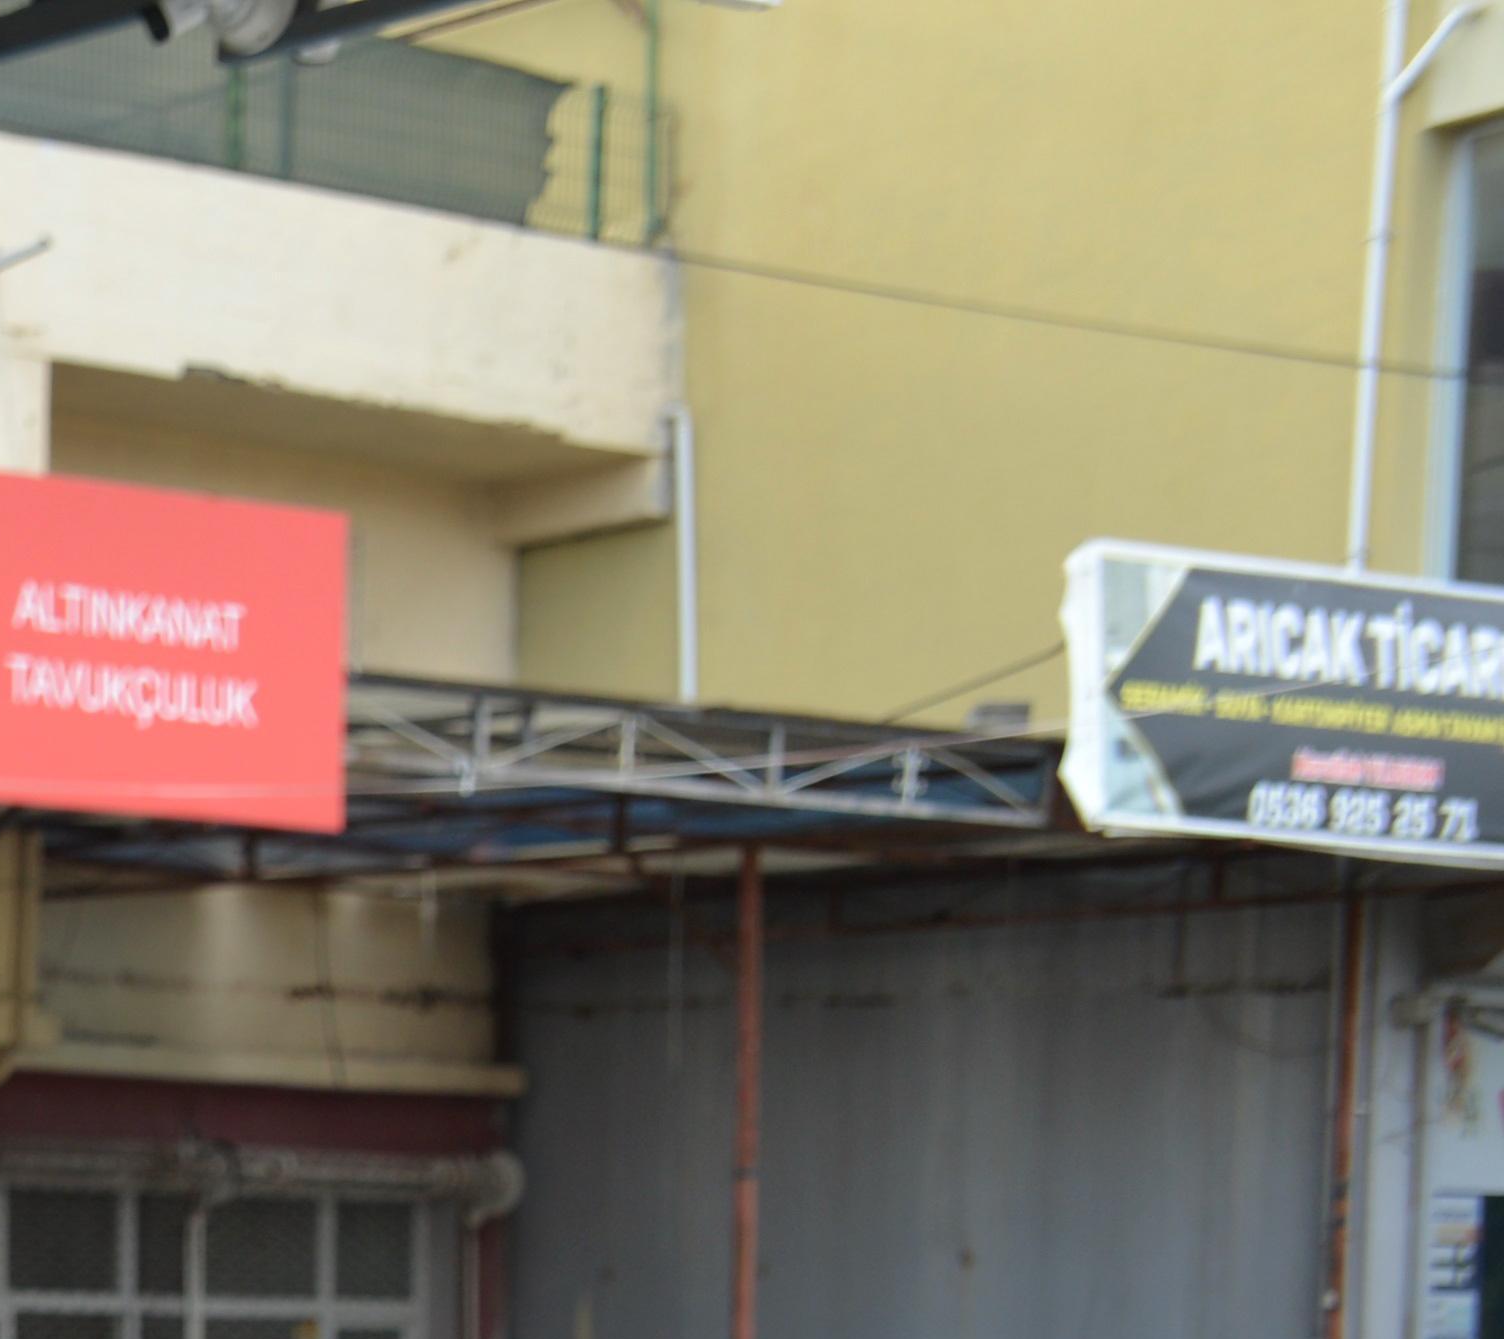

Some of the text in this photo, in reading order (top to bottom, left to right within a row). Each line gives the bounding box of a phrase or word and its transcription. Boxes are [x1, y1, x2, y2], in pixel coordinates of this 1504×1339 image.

[10, 576, 248, 654] ALTINKANAT
[1193, 594, 1365, 687] ARICAK
[2, 650, 260, 730] TAVUKÇULUK
